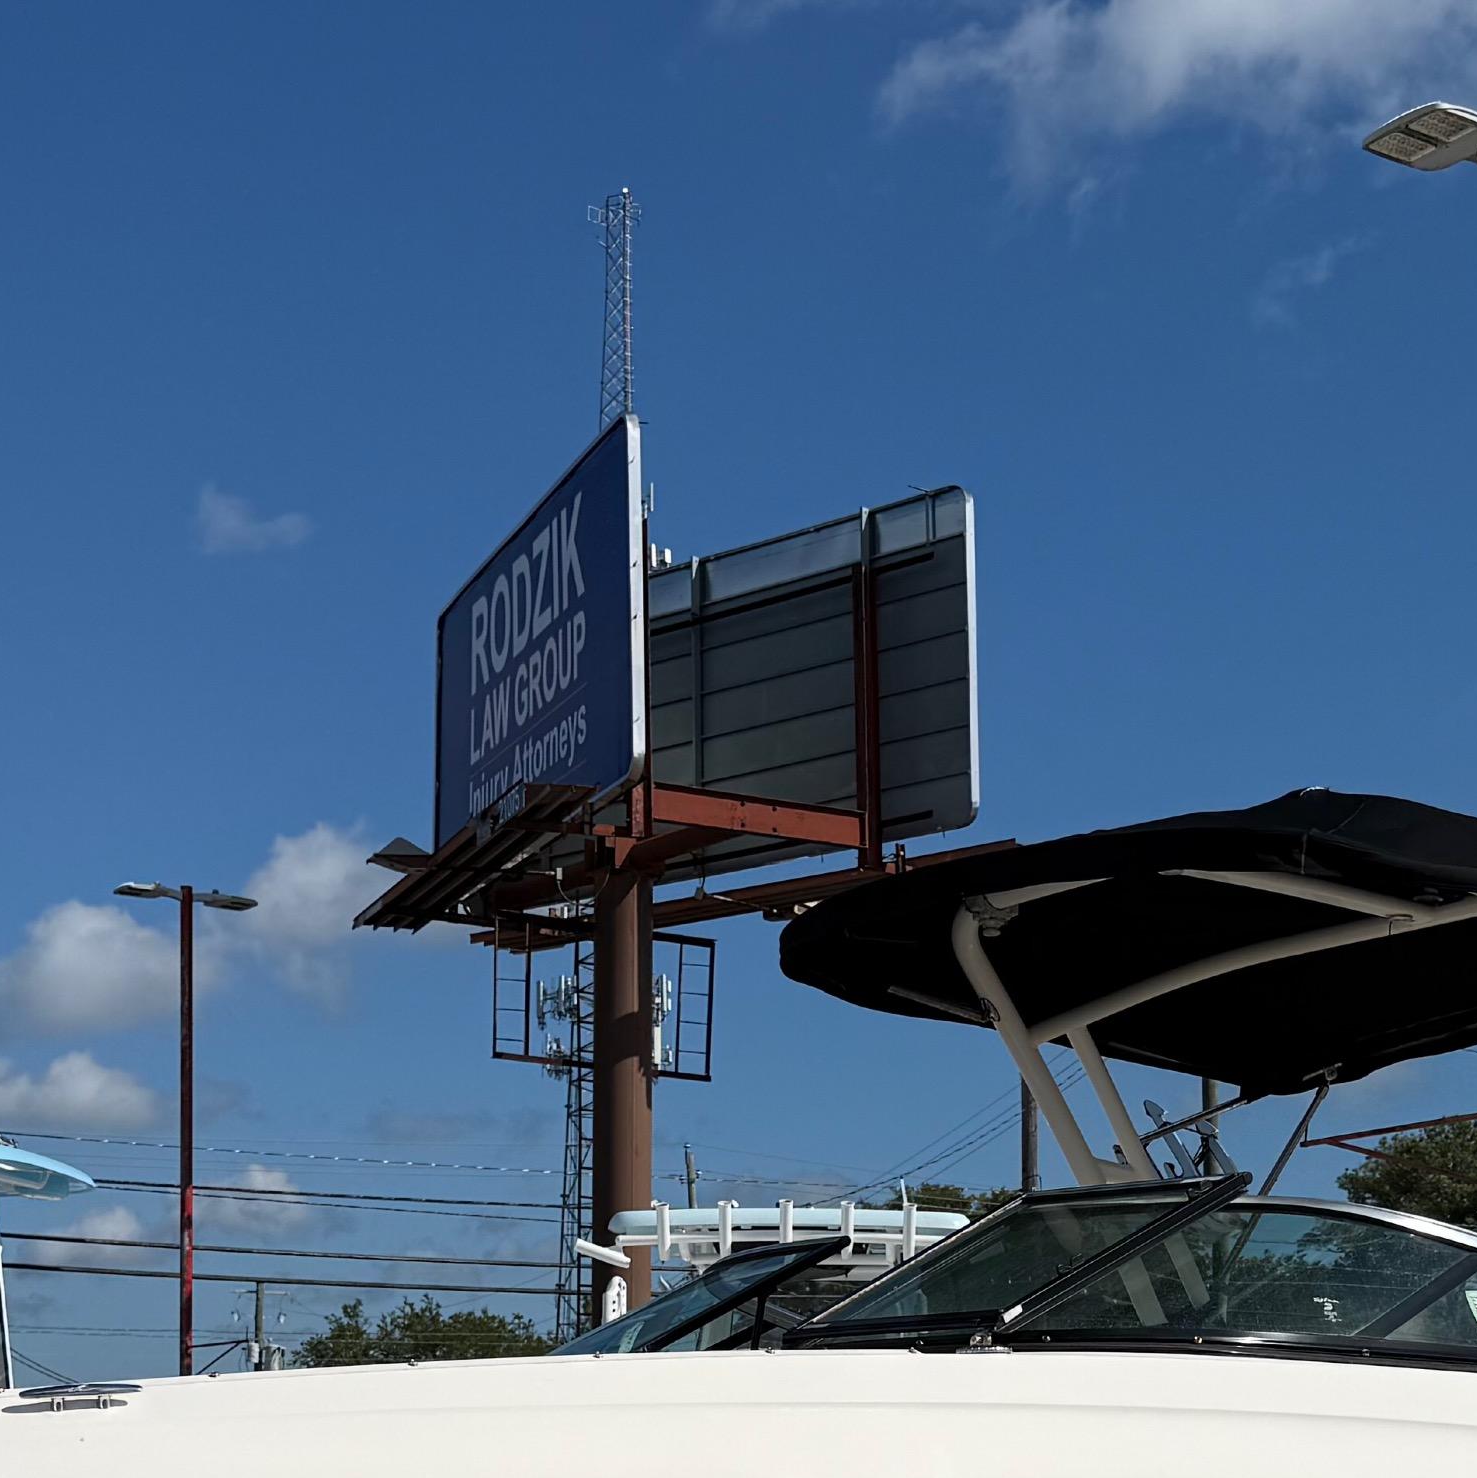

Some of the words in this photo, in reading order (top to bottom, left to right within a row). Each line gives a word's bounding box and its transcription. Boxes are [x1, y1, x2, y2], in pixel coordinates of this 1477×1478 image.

[470, 491, 586, 695] RODZIK
[470, 676, 511, 767] LAW
[514, 610, 586, 728] GROUP
[512, 704, 587, 784] Attorneys
